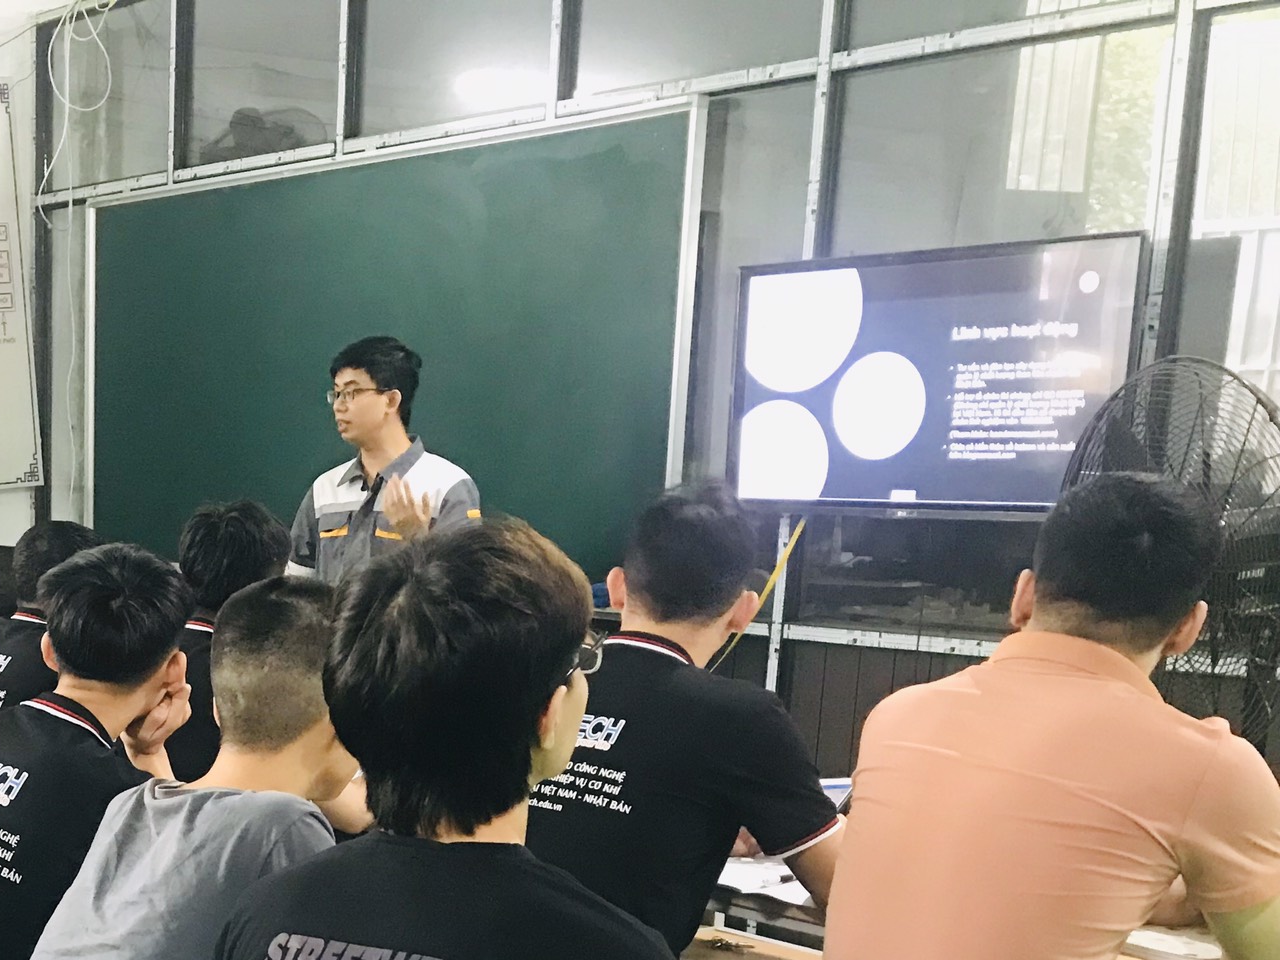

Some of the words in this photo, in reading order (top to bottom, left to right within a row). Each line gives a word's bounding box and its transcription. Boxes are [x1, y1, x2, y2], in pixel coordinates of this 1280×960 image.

[576, 713, 626, 745] ECH
[573, 761, 598, 775] CÔNG
[598, 767, 627, 784] NGHỆ
[575, 776, 588, 789] VỤ
[588, 780, 602, 790] CƠ
[602, 784, 622, 796] KHÍ
[557, 786, 577, 800] NAM
[582, 793, 609, 808] NHẬT
[609, 800, 632, 815] BẢN
[0, 865, 23, 884] BẢN
